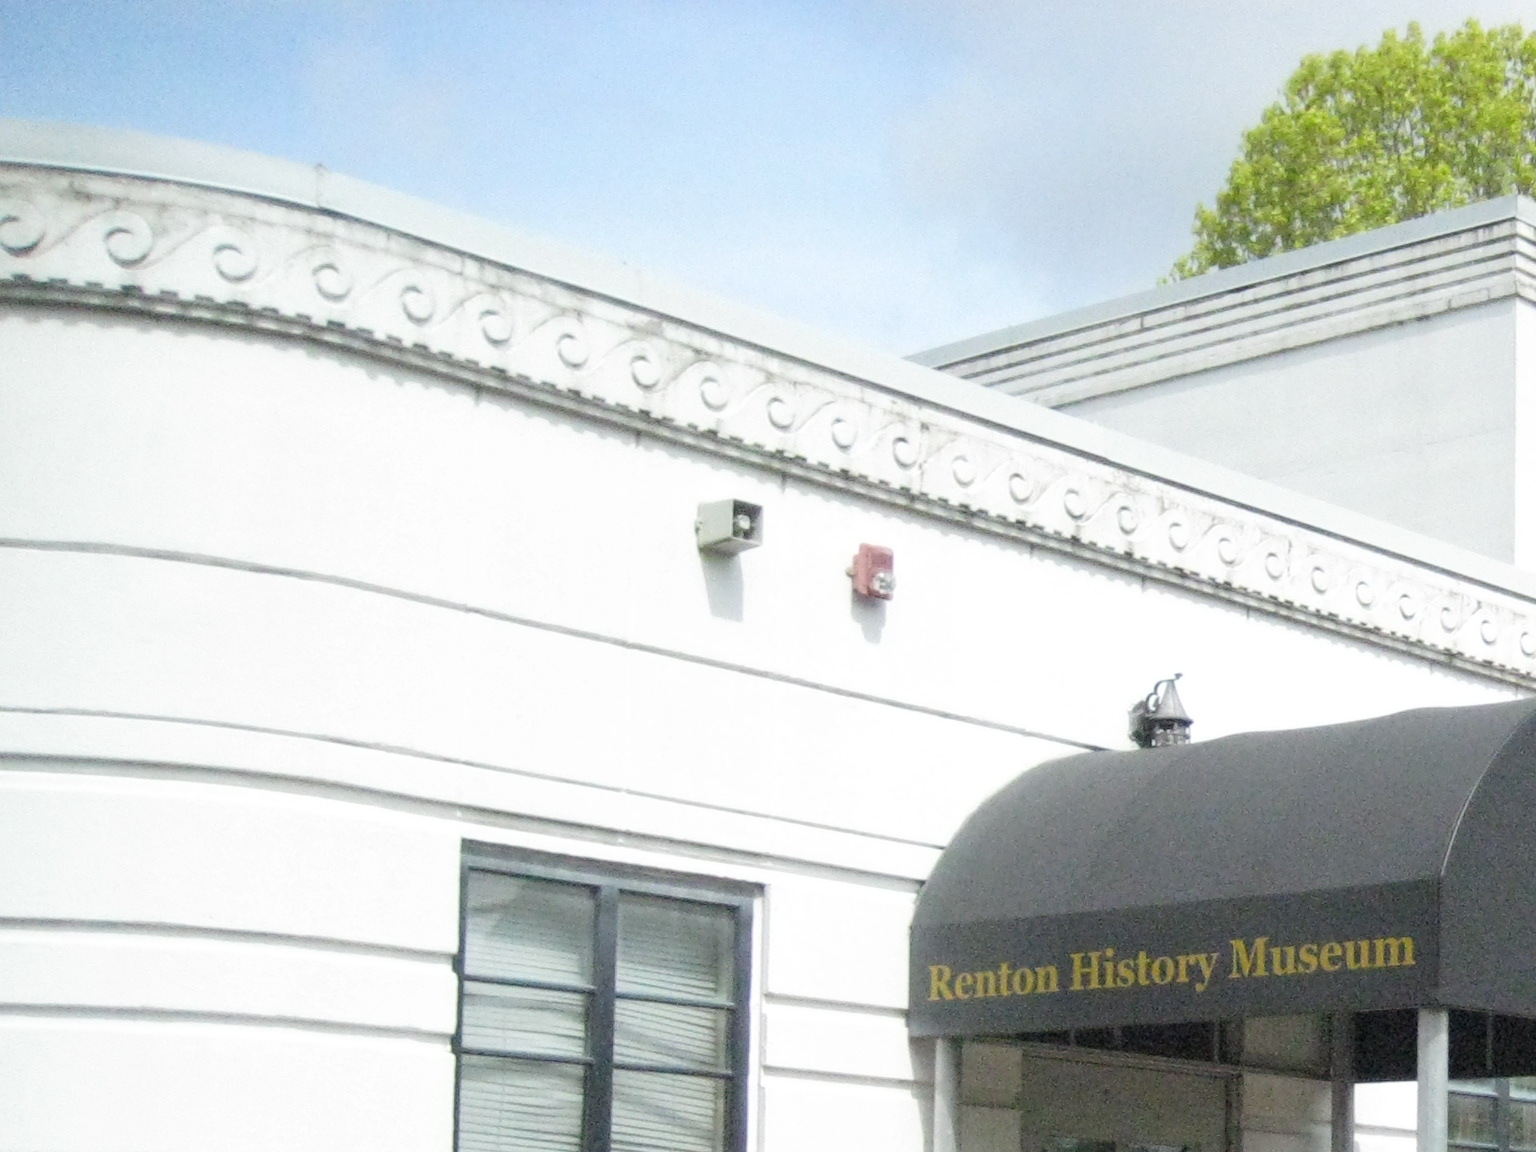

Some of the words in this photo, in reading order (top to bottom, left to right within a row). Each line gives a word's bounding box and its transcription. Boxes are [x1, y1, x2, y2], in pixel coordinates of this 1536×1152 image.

[927, 963, 1060, 1001] Renton
[1069, 947, 1219, 992] History
[1228, 934, 1417, 980] Museum
